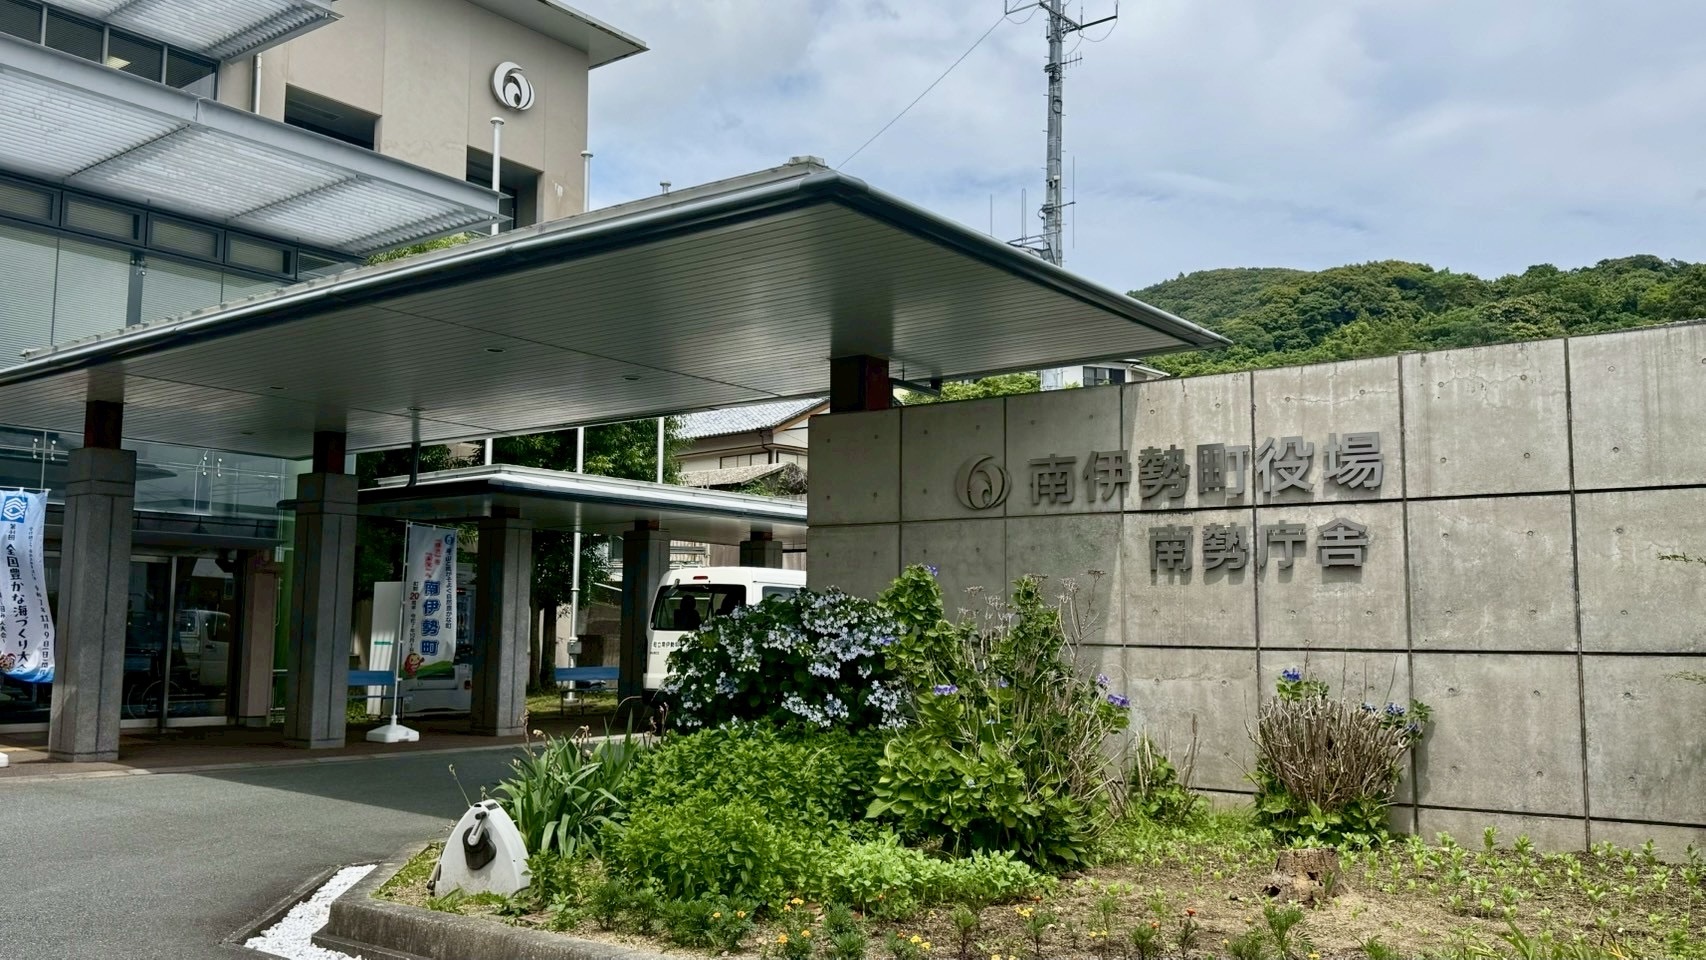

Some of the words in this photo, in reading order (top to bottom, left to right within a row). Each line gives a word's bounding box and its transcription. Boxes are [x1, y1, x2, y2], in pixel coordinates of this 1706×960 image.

[1029, 432, 1384, 504] 南伊勢町役場
[1149, 517, 1368, 571] 南勢庁舎
[420, 580, 441, 656] 南伊勢町
